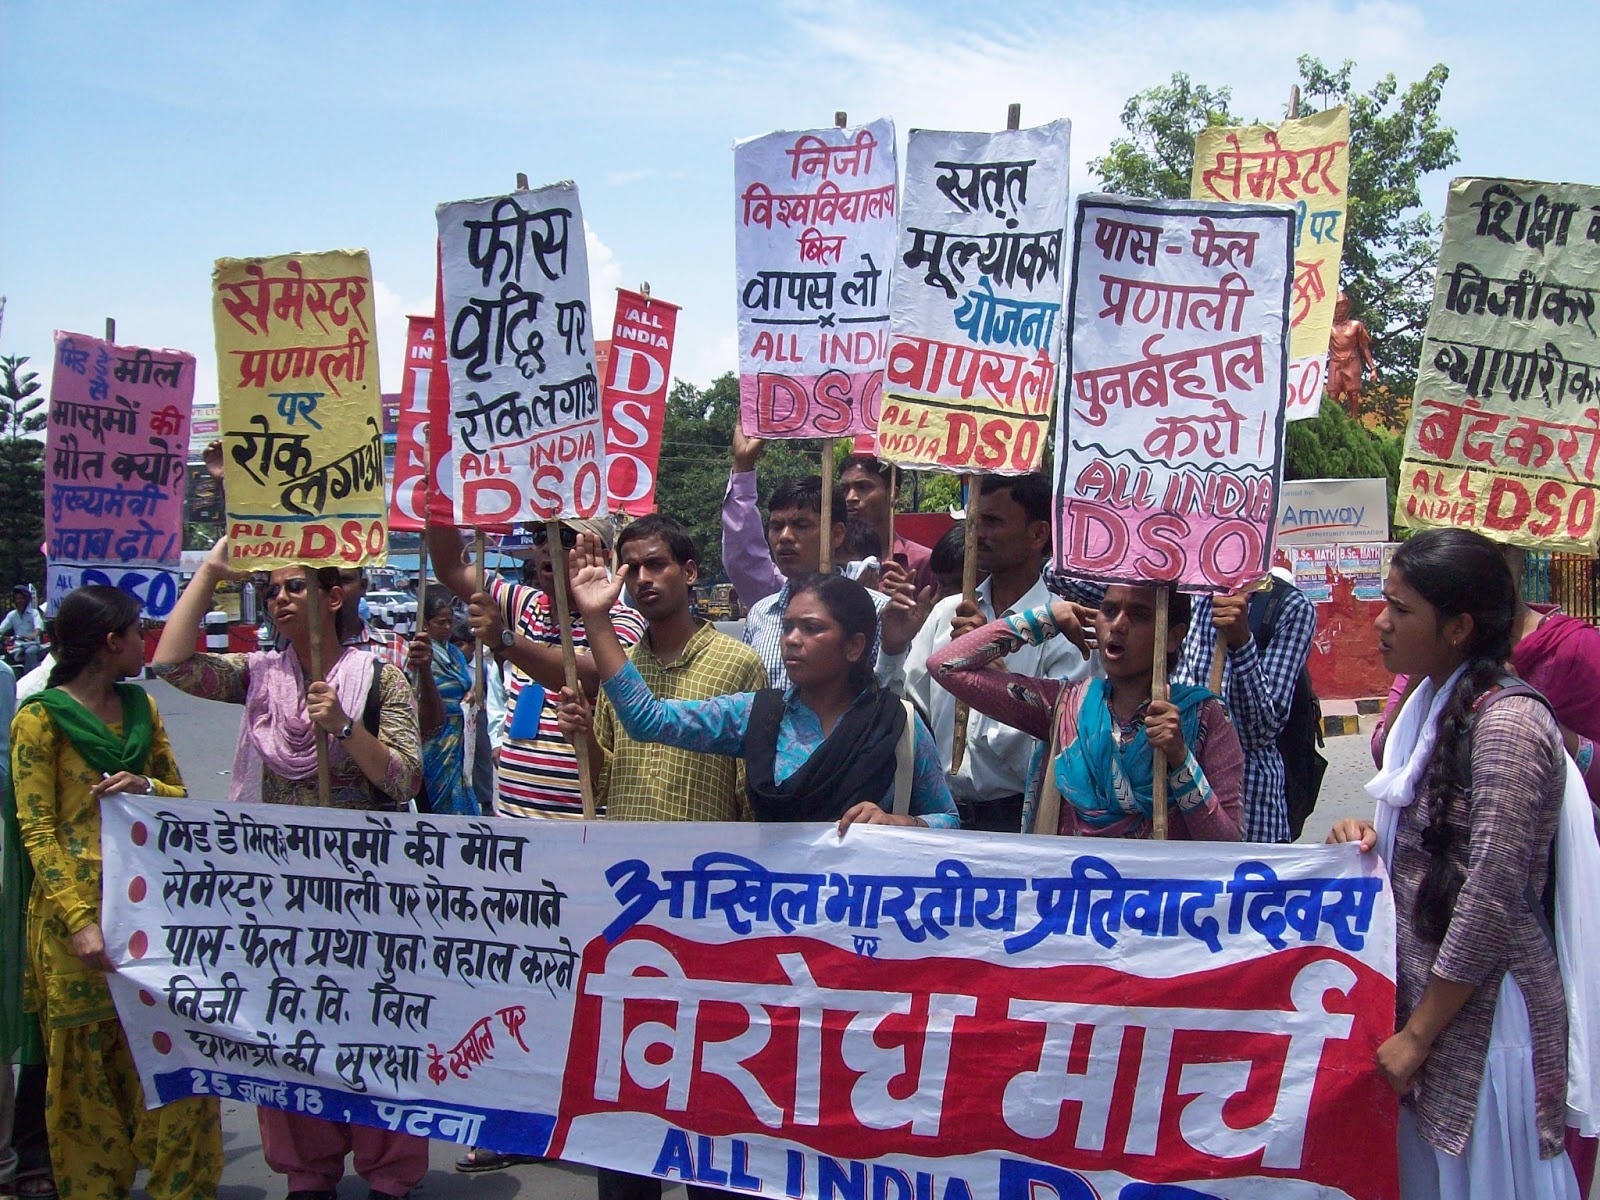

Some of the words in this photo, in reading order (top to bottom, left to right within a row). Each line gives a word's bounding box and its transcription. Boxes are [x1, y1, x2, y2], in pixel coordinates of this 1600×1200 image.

[786, 130, 877, 180] निजी
[742, 180, 895, 230] विश्वविद्यालय
[1311, 210, 1341, 243] पर
[1470, 184, 1580, 256] शिक्षा
[463, 197, 572, 286] फीस
[796, 227, 847, 266] बिल
[218, 260, 369, 336] सेमेस्टर
[628, 308, 662, 329] ALL
[743, 271, 837, 311] वापस
[954, 275, 1060, 350] योजना
[1099, 273, 1254, 332] प्रणाली
[1443, 262, 1600, 339] निजीकर
[555, 300, 587, 355] पर
[616, 325, 668, 349] INDIA
[751, 331, 803, 364] ALL
[820, 329, 886, 364] INDI
[114, 348, 184, 388] मील
[229, 328, 369, 398] प्रणाली
[150, 405, 184, 437] की
[267, 392, 324, 430] पर
[883, 405, 930, 428] ALL
[1418, 399, 1510, 468] बंद
[53, 433, 106, 483] मौत
[225, 415, 312, 486] रोक
[278, 416, 382, 516] लगाओ
[460, 454, 512, 479] ALL
[530, 431, 596, 472] INDIA
[879, 432, 941, 460] INDIA
[937, 413, 1041, 470] DSO
[463, 462, 601, 523] DSO
[1074, 458, 1155, 506] ALL
[1163, 470, 1273, 524] INDIA
[1406, 494, 1477, 526] INDIA
[1412, 468, 1477, 500] ALL
[1483, 477, 1596, 539] DSO
[230, 523, 286, 539] ALL
[297, 521, 385, 562] DSO
[1067, 499, 1263, 587] DSO
[1282, 505, 1365, 528] Amway
[51, 528, 114, 561] जवाब
[233, 541, 294, 559] INDIA
[155, 811, 212, 854] मिड
[213, 809, 241, 855] डे
[283, 816, 397, 873] मासूमों
[404, 821, 452, 869] की
[456, 822, 530, 877] मौत
[162, 859, 275, 917] सेमेस्टर
[280, 870, 385, 925] प्रणाली
[386, 881, 422, 928] पर
[423, 874, 478, 930] रोक
[602, 851, 827, 945] अखिल
[825, 858, 1026, 943] भारतीय
[1003, 855, 1224, 955] प्रतिवाद
[1227, 861, 1383, 952] दिवस
[304, 928, 372, 970] प्रथा
[433, 936, 521, 989] बहाल
[519, 936, 581, 1000] करने
[368, 982, 437, 1033] बिल
[282, 1029, 326, 1076] की
[335, 1043, 424, 1093] सुरक्षा
[426, 1043, 447, 1086] के
[495, 1005, 530, 1053] पर
[585, 939, 977, 1136] विरोध
[1002, 959, 1356, 1170] मार्च
[190, 1069, 232, 1097] 25
[237, 1080, 290, 1110] जुलाई
[370, 1099, 487, 1146] पटना
[651, 1127, 762, 1191] ALL
